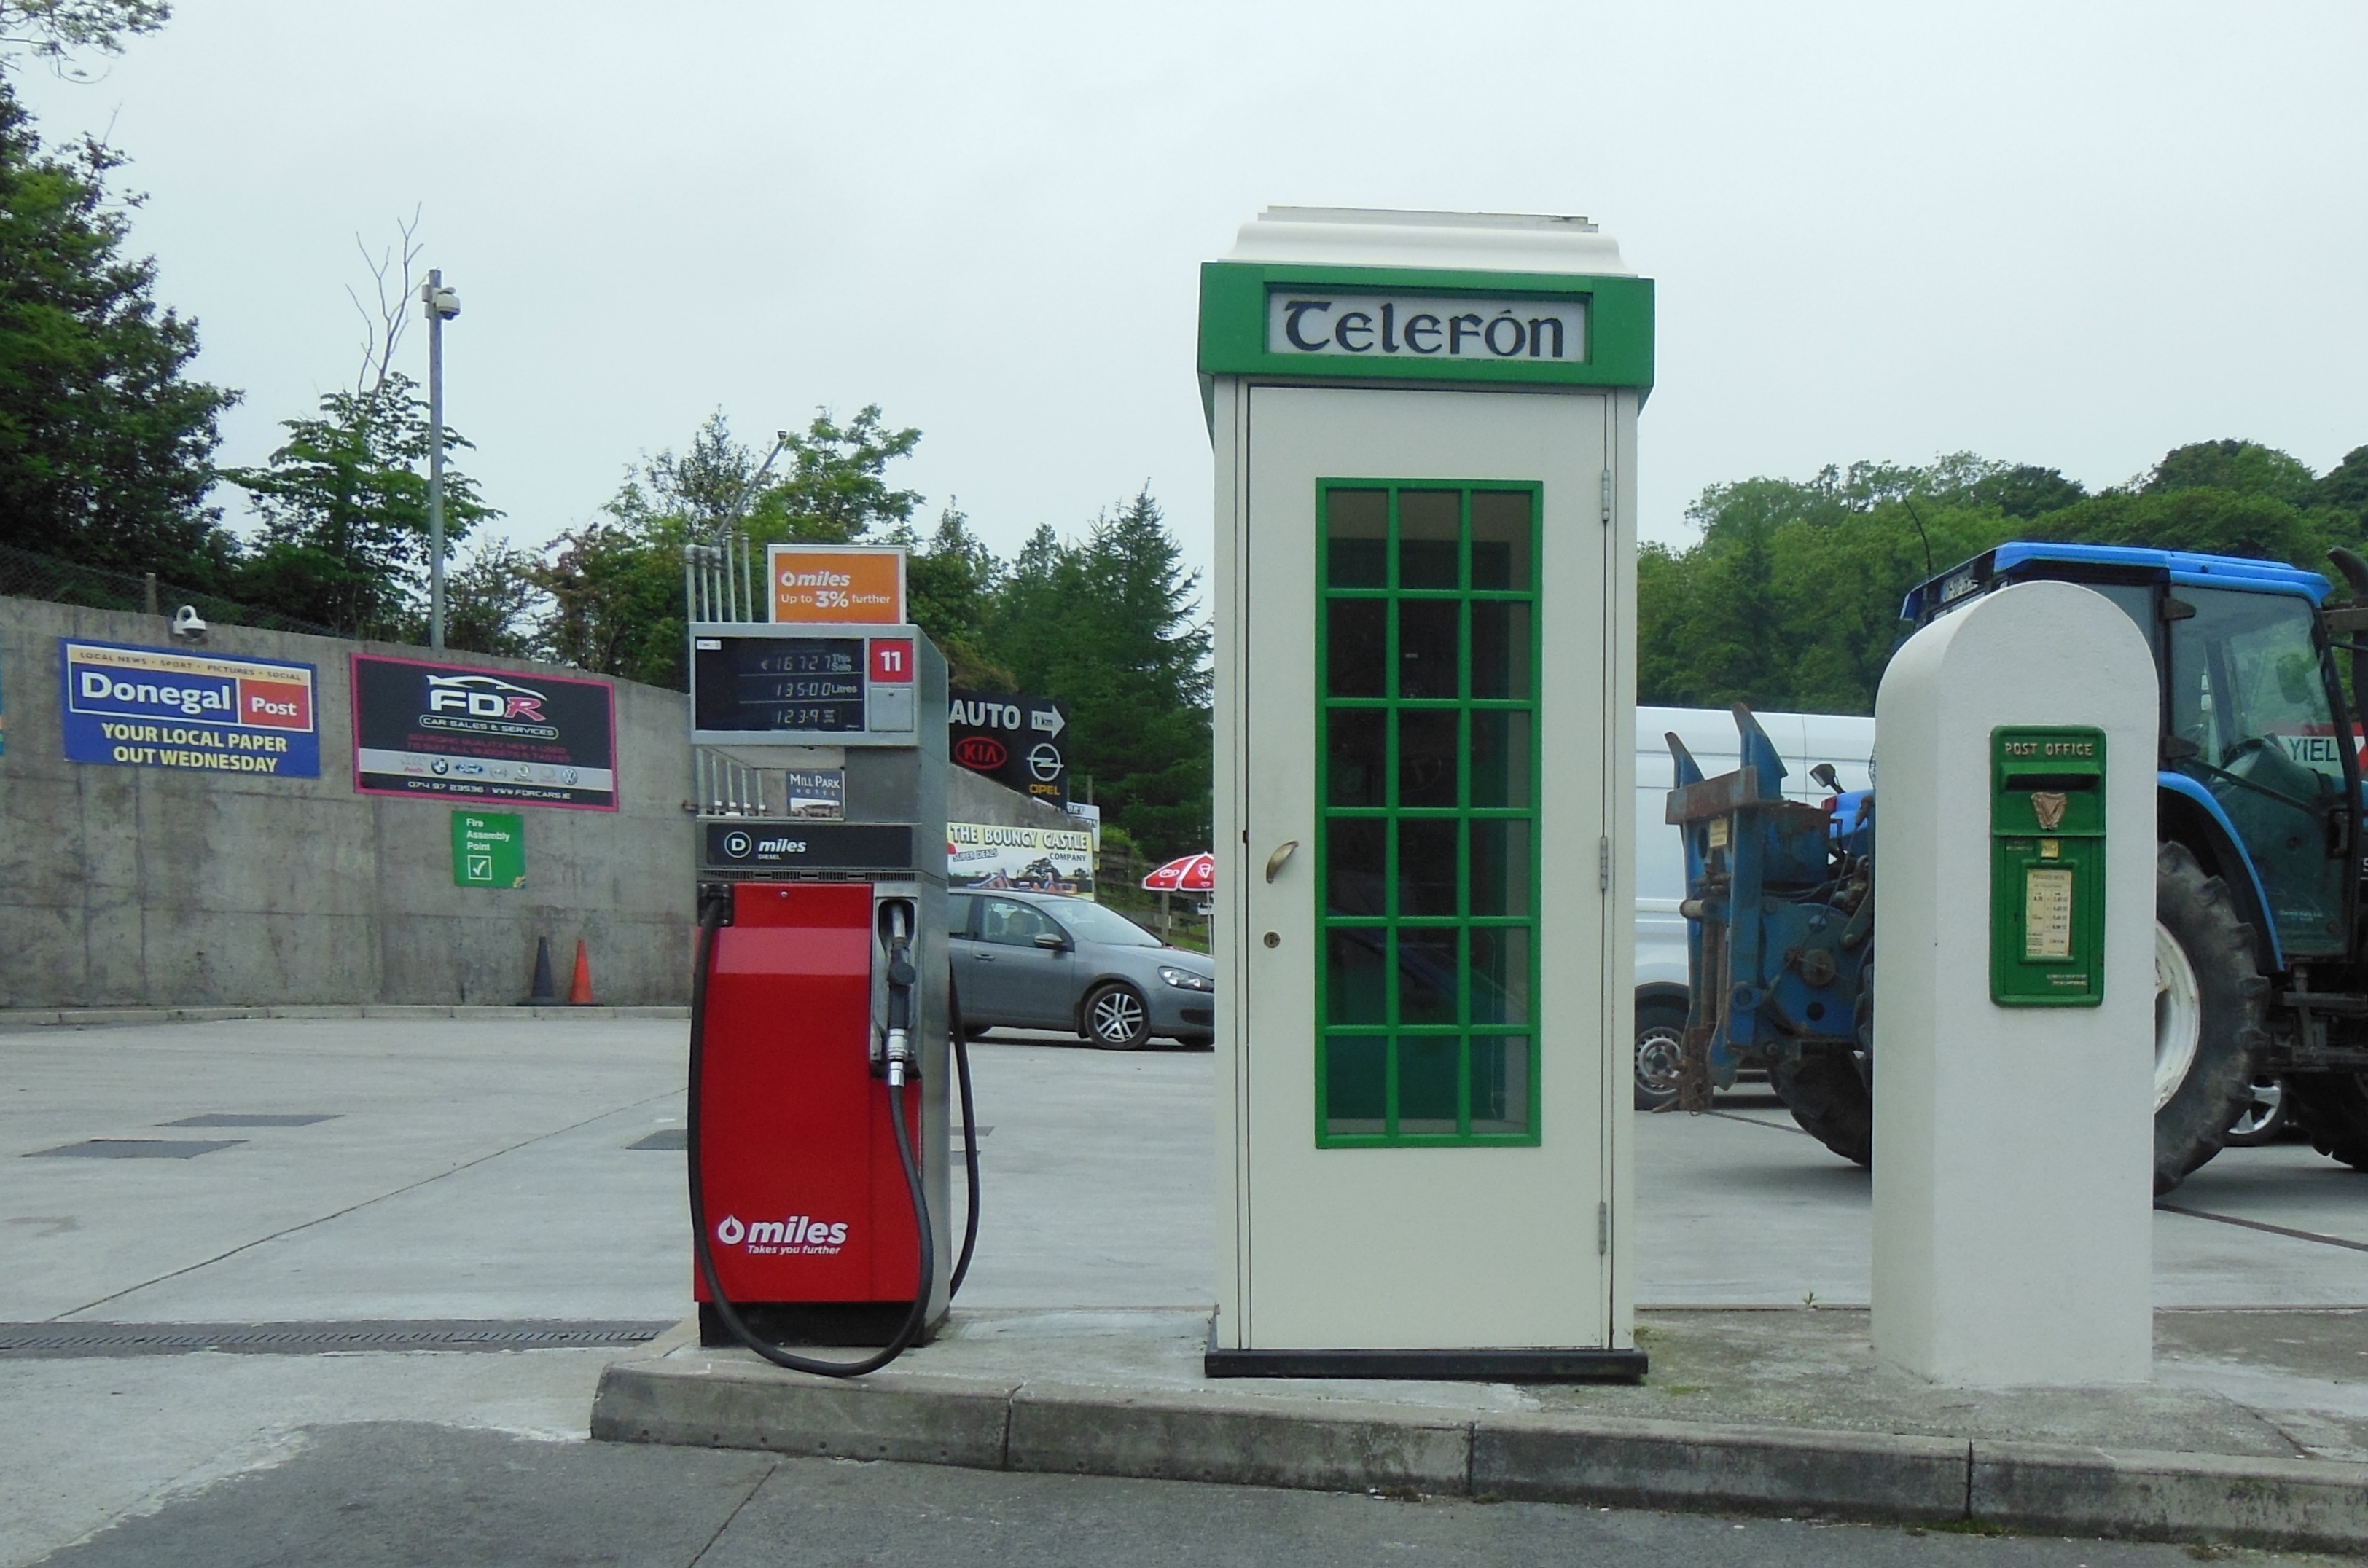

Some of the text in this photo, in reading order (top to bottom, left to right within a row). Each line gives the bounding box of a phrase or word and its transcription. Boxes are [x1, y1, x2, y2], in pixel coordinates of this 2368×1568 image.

[797, 571, 851, 587] miles
[781, 590, 891, 608] Up to 3% further
[80, 652, 301, 681] LOCAL NEWS SPORT PICTURES SOCIAL
[880, 651, 901, 672] 11
[81, 671, 230, 715] Donegal
[832, 684, 858, 694] Litres
[251, 697, 297, 716] Post
[430, 689, 547, 722] FDR
[948, 699, 1021, 730] AUTO
[1041, 716, 1053, 727] km
[423, 717, 447, 726] CAR
[450, 720, 488, 730] SALES
[501, 726, 555, 736] SERVICES
[102, 722, 287, 753] YOUR LOCAL PAPER
[964, 743, 998, 762] KIA
[2005, 742, 2093, 756] POST OFFICE
[2289, 738, 2338, 762] YIEL
[113, 745, 278, 773] OUT WEDNESDAY
[789, 773, 840, 788] MILL PARK
[796, 788, 836, 796] HOTEL
[1029, 783, 1060, 796] OPEL
[466, 818, 484, 827] Fire
[466, 830, 510, 842] Assembly
[950, 825, 1088, 851] THE BOUNCY CASTLE
[467, 842, 491, 851] Point
[731, 838, 746, 851] D
[758, 838, 808, 852] miles
[952, 848, 999, 863] SUPER DEALS
[1050, 852, 1086, 862] COMPANY
[747, 1215, 849, 1244] miles
[748, 1244, 840, 1255] Takes you further
